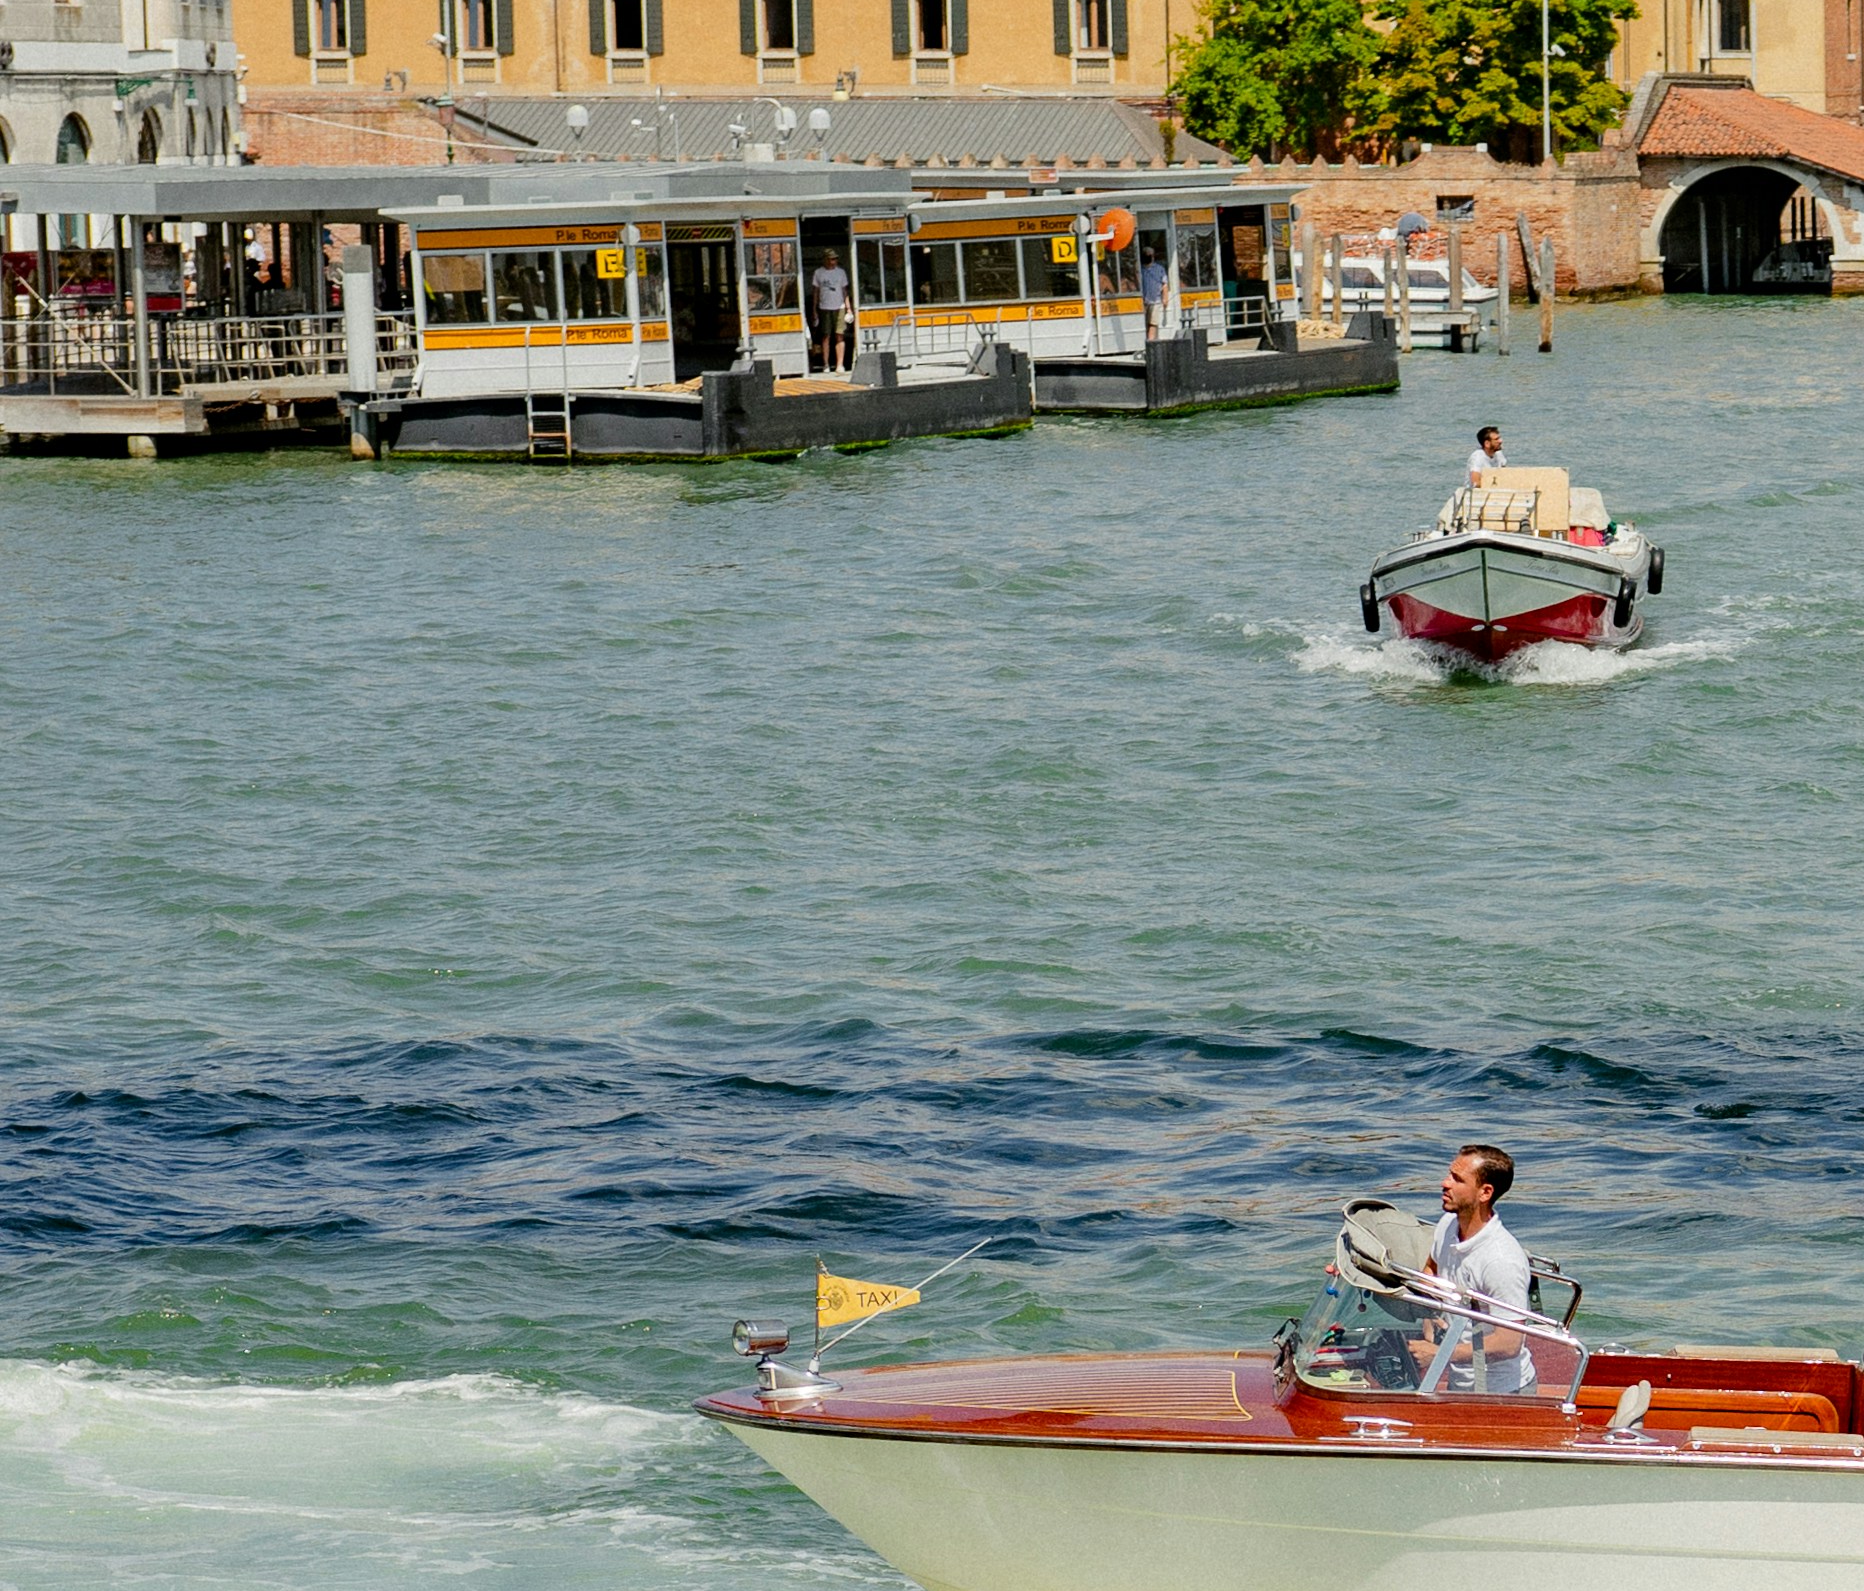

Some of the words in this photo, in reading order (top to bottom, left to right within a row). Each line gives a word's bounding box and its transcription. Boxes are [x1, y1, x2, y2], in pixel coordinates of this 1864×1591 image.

[1040, 219, 1071, 230] Roma
[555, 229, 577, 241] P.le
[581, 228, 618, 240] Roma
[1058, 240, 1073, 258] D
[1048, 304, 1080, 316] Roma
[565, 328, 587, 340] P.le
[591, 327, 628, 339] Roma
[856, 1290, 899, 1308] TAXI
